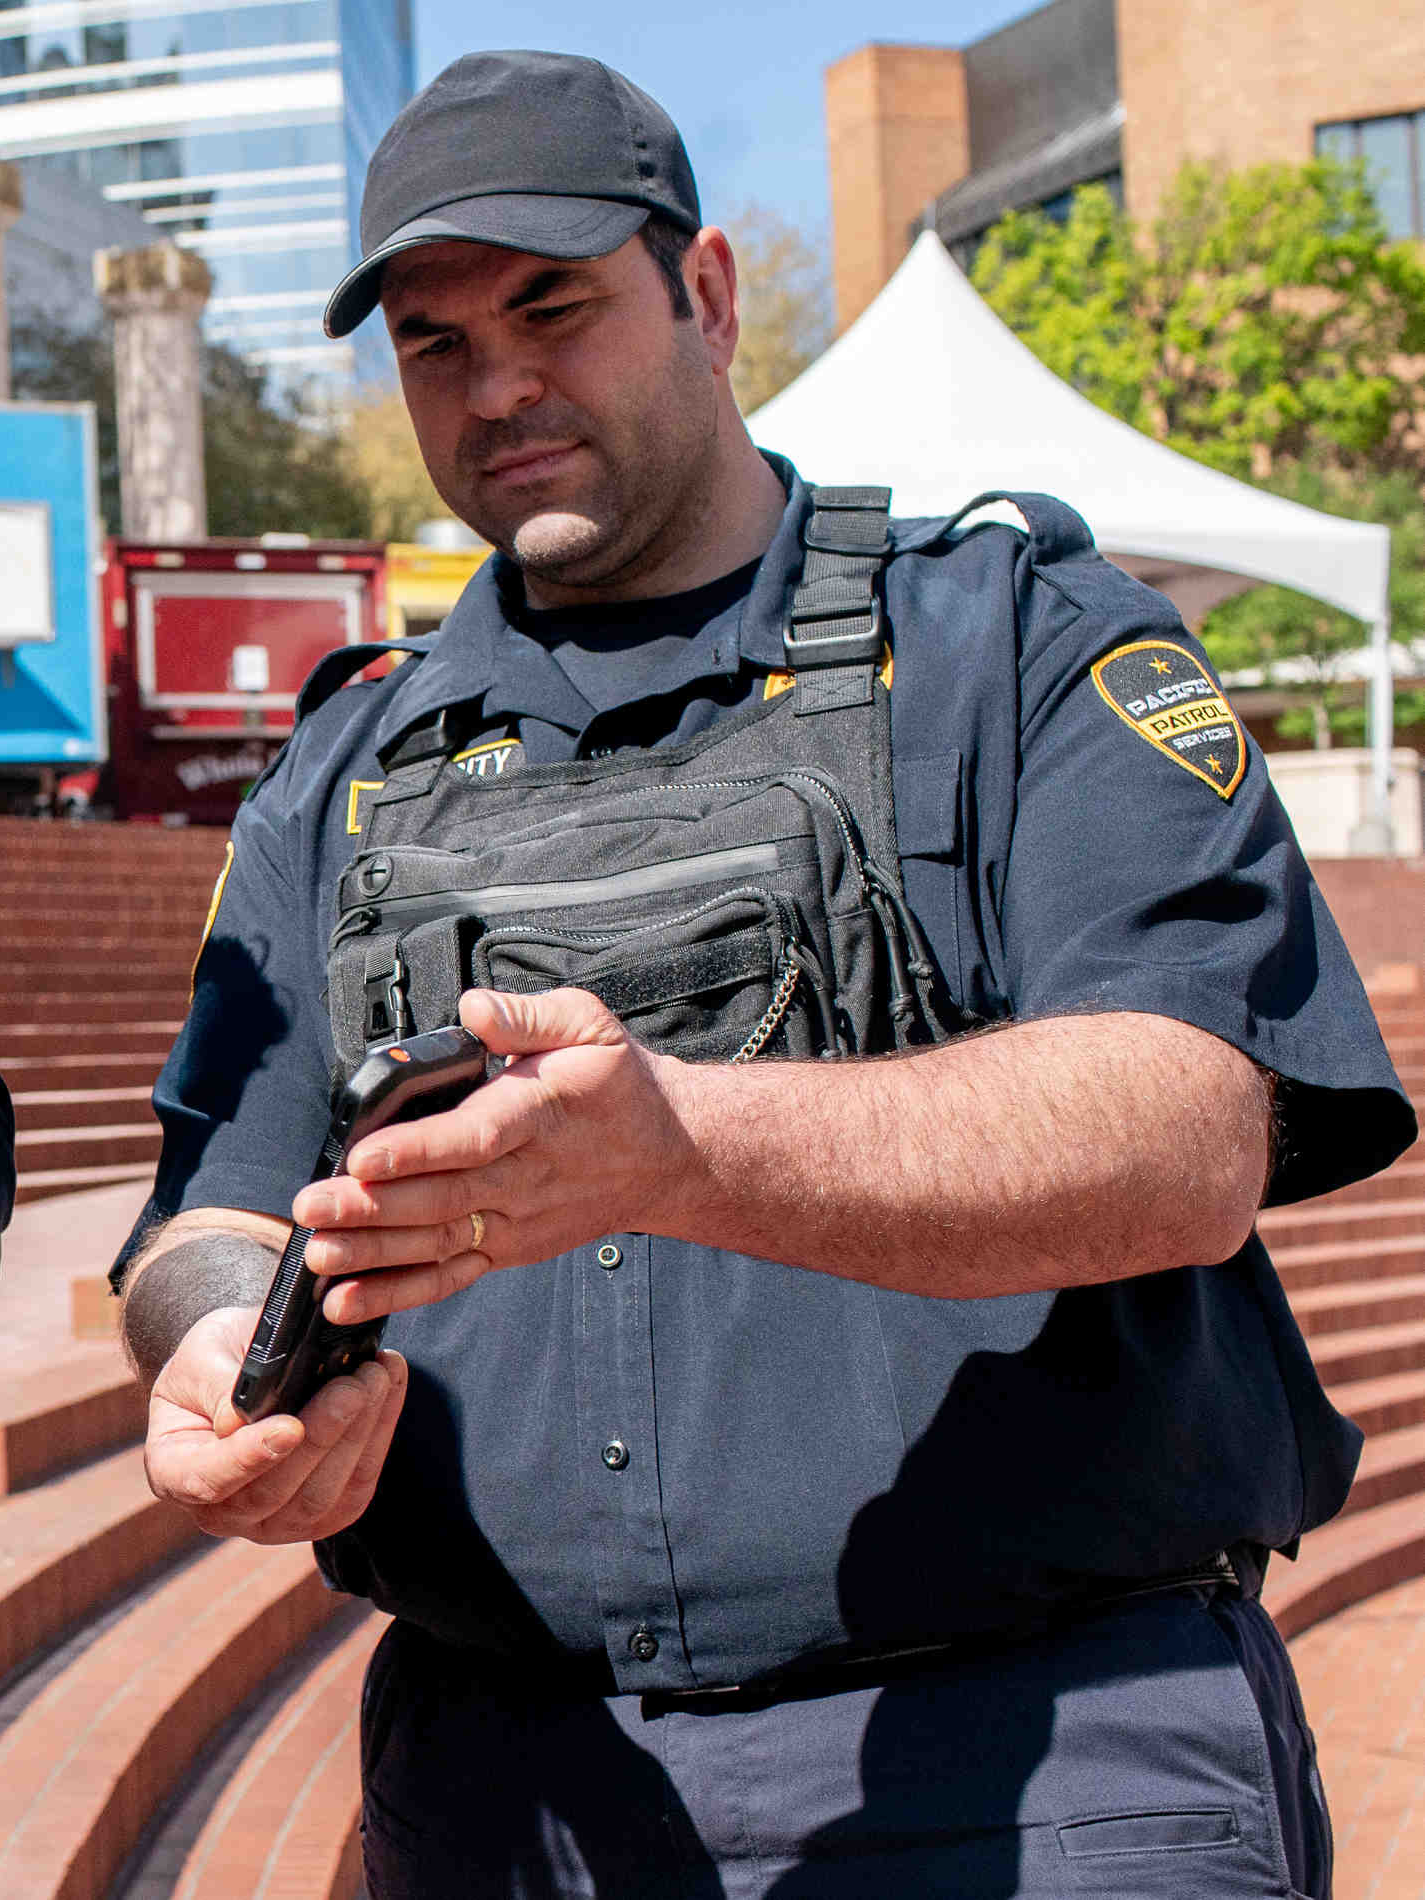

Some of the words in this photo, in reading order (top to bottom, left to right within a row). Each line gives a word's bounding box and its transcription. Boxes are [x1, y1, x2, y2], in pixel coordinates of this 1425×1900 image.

[1125, 678, 1213, 717] PACIFIC
[1150, 704, 1229, 734] PATROL
[1173, 726, 1233, 750] SERVICES
[456, 747, 512, 776] ITY
